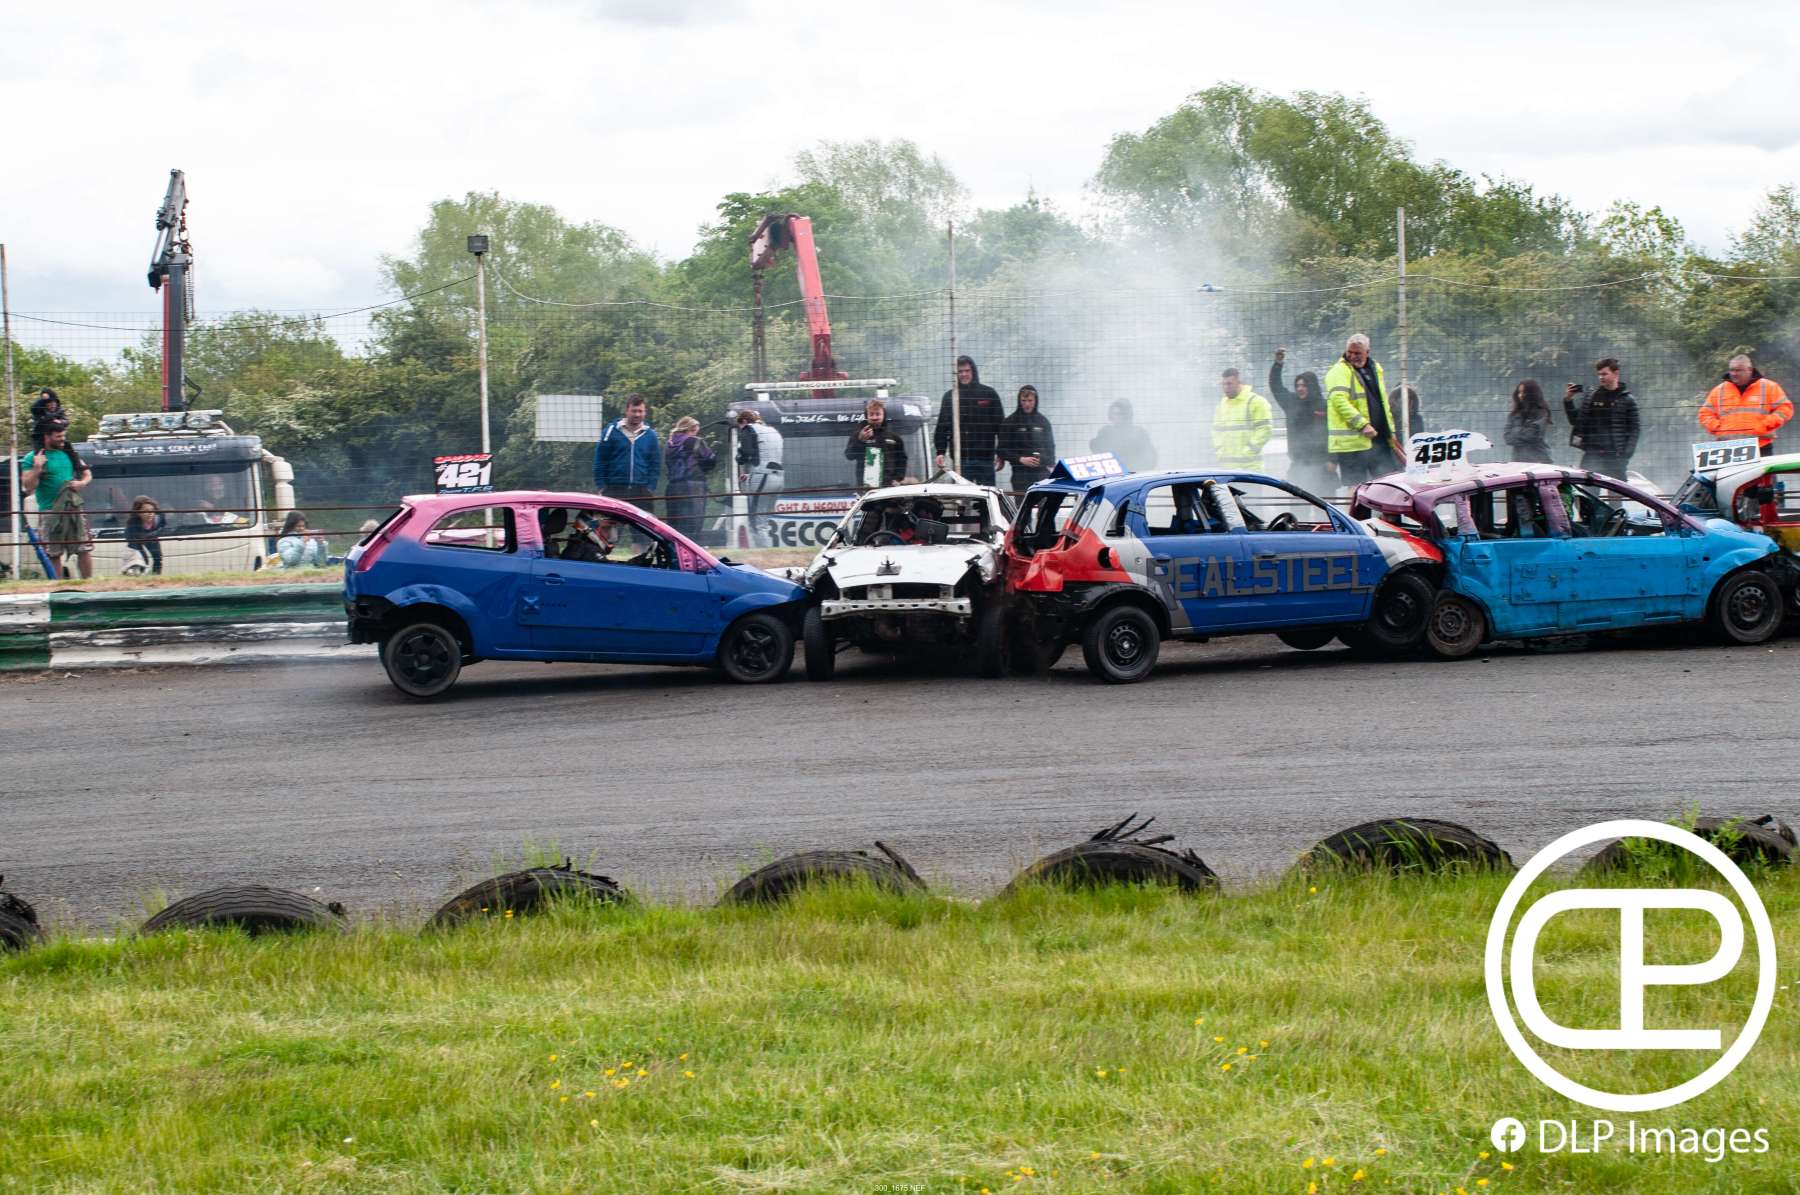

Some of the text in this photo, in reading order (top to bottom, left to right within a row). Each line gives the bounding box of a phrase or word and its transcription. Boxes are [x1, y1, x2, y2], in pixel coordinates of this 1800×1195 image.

[1411, 432, 1471, 444] POLAR
[1415, 440, 1462, 464] 438
[1696, 446, 1756, 467] 139
[776, 502, 798, 512] GHT
